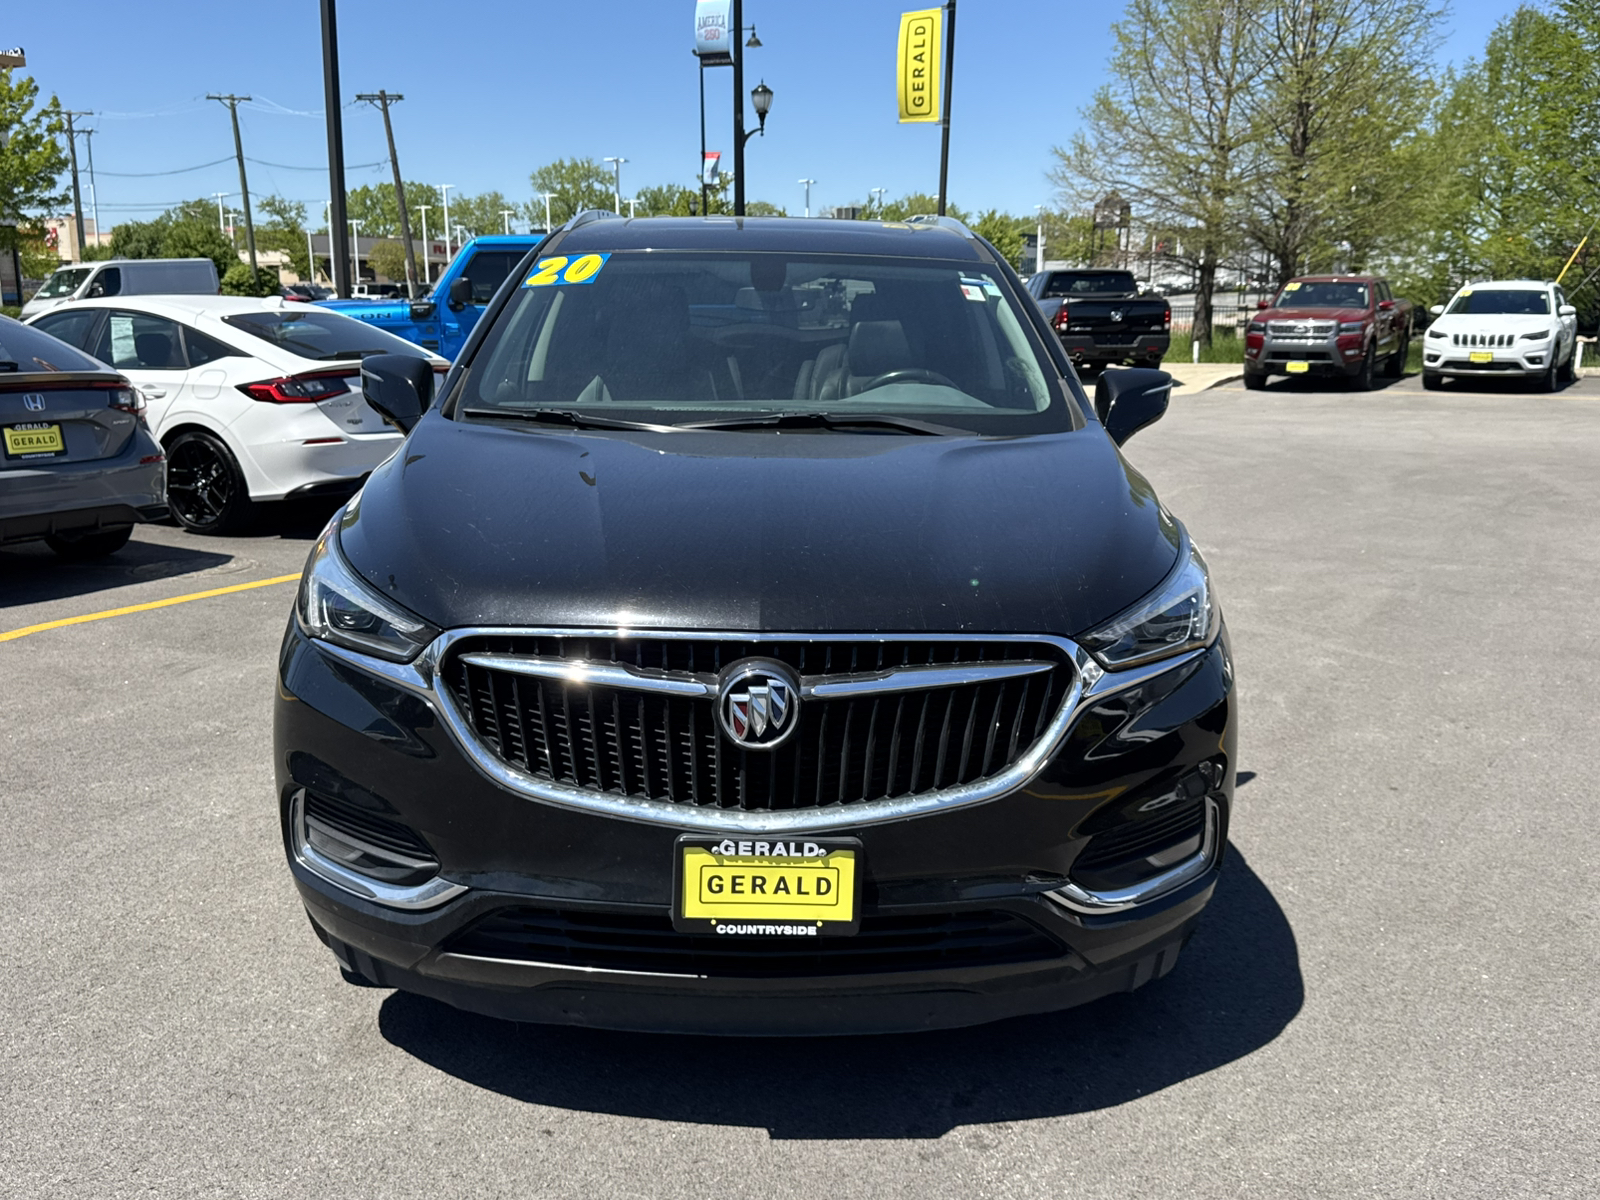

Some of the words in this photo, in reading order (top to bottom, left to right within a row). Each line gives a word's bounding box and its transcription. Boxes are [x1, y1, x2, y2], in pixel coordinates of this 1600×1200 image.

[697, 13, 726, 31] AMERICA
[704, 28, 720, 40] 250
[912, 25, 926, 108] GERALD
[525, 254, 604, 286] 20
[16, 423, 49, 431] GERALD
[13, 434, 55, 447] GERALD
[719, 839, 819, 857] GERALD
[707, 875, 832, 896] GERALD
[716, 924, 817, 936] COUNTRYSIDE
